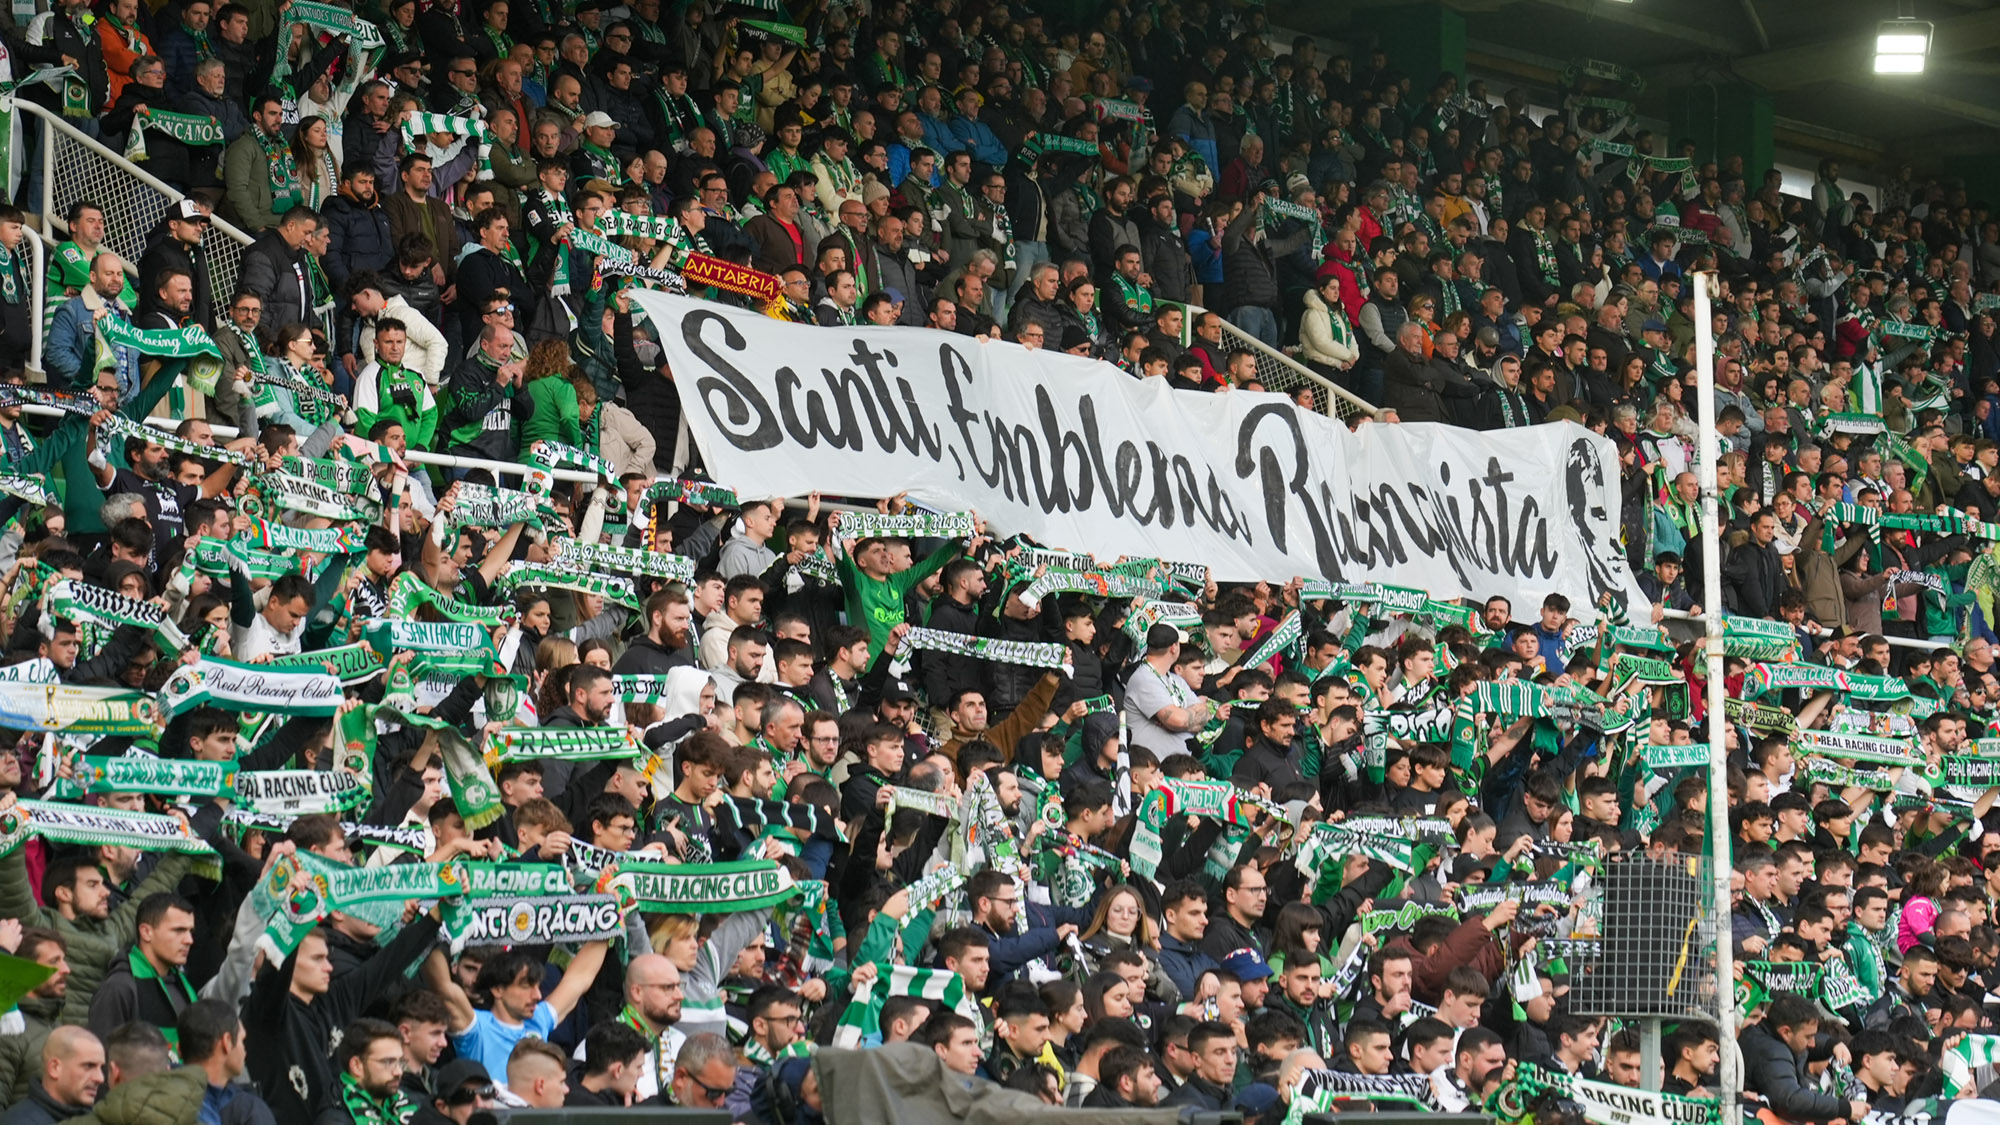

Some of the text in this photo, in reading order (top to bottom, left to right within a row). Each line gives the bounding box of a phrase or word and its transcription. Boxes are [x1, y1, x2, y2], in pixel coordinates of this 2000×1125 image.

[1020, 146, 1037, 161] RRC
[600, 215, 624, 230] REAL
[625, 218, 663, 237] RACING
[131, 326, 181, 355] Racing
[306, 461, 344, 482] RACING
[346, 466, 370, 485] CLUB
[289, 480, 331, 504] RACING
[845, 515, 864, 531] DE
[864, 512, 914, 531] PADRES
[927, 513, 969, 533] HIJOS
[270, 521, 337, 549] SANTANDER
[1036, 554, 1071, 571] RACING
[1072, 556, 1095, 573] CLUB
[401, 622, 474, 648] SANTANDER
[983, 639, 1063, 665] MALDITOS
[1633, 660, 1662, 677] RACING
[1773, 665, 1834, 681] RACING CLUB
[207, 666, 334, 708] Real Racing Club
[520, 730, 623, 753] RACING
[1820, 735, 1901, 755] REAL RACING CLUB
[1948, 762, 1992, 778] REAL RACING
[264, 775, 318, 799] RACING
[320, 773, 357, 794] CLUB
[31, 808, 179, 837] REAL RACING CLUB
[472, 869, 542, 891] RACING
[633, 871, 780, 900] REAL RACING CLUB
[536, 901, 620, 940] RACING
[1765, 971, 1795, 991] RACING
[1581, 1086, 1708, 1124] RACING CLUB
